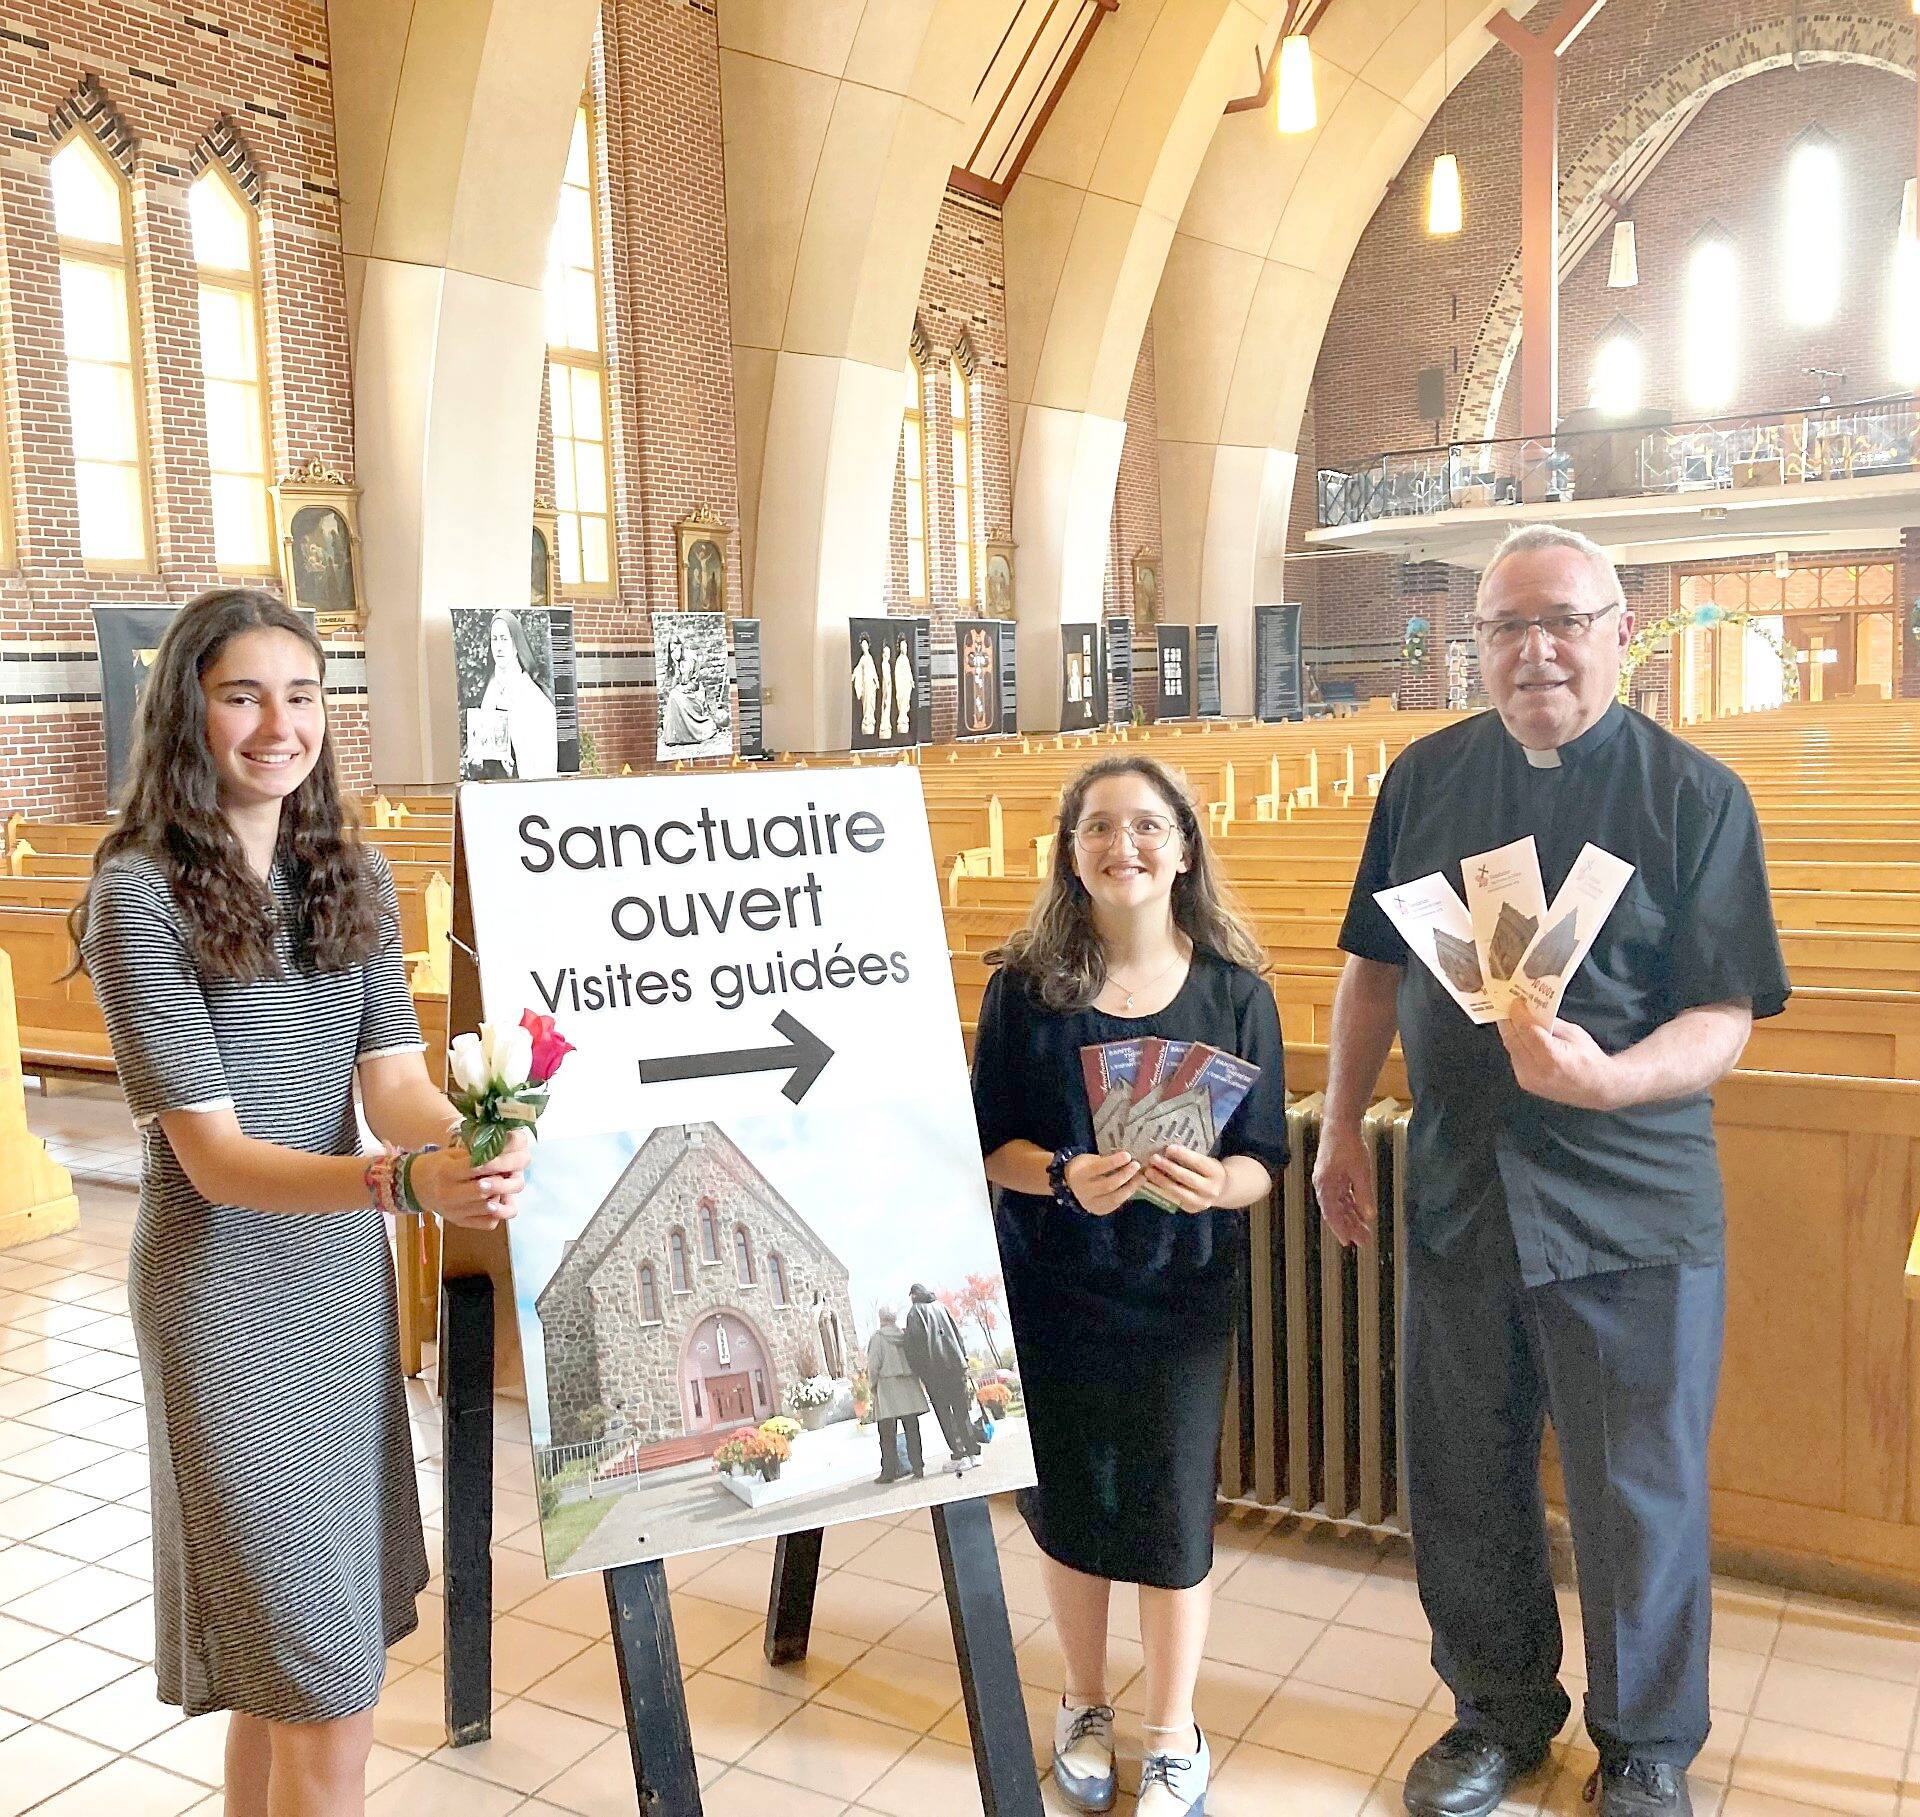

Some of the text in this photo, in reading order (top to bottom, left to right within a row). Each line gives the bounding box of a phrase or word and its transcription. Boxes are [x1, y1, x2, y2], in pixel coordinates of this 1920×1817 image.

[519, 801, 885, 873] Sanctuaire
[611, 872, 822, 941] ouvert
[530, 942, 909, 1013] Visites guidées
